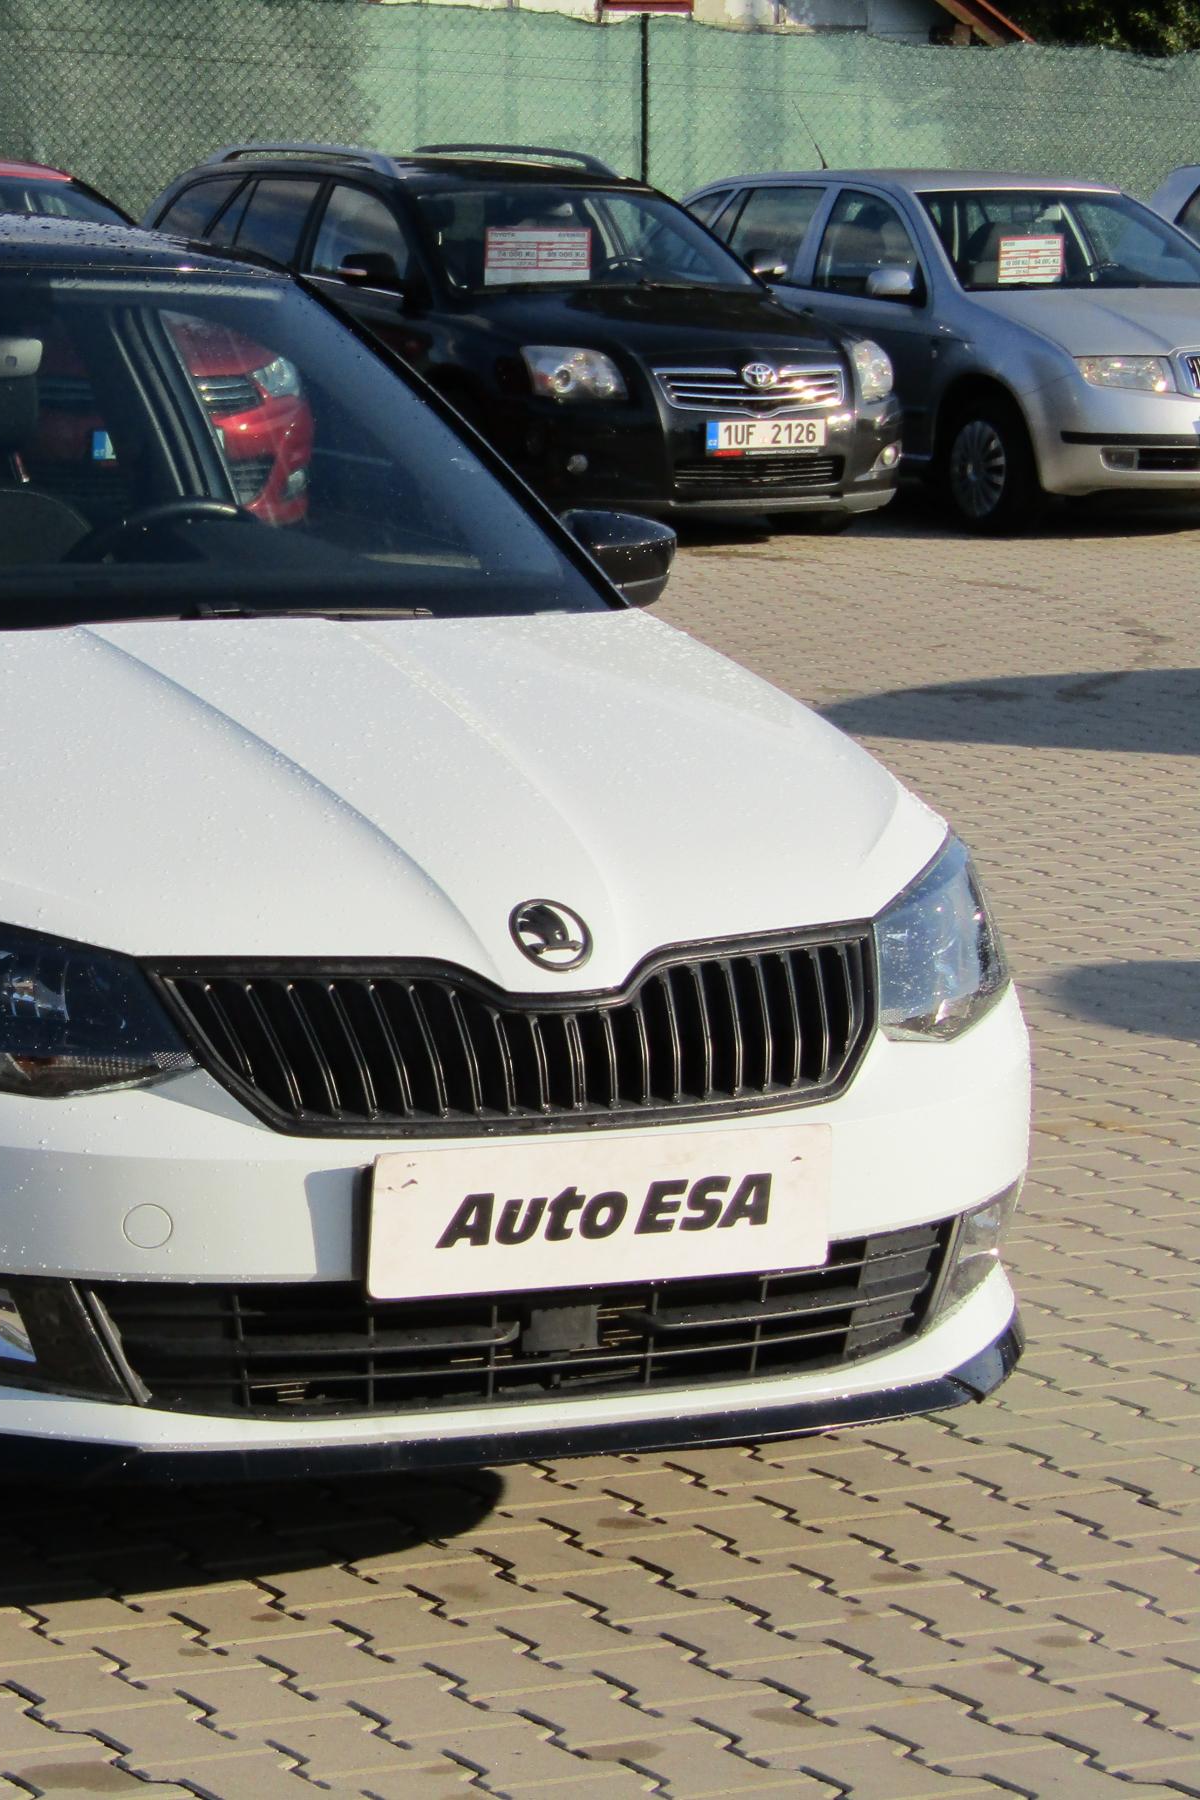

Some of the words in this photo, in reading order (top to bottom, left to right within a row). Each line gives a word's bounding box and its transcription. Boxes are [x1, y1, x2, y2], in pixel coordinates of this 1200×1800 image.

[724, 424, 756, 446] 1UF
[771, 422, 817, 445] 2126
[434, 1185, 629, 1249] Auto
[633, 1172, 773, 1235] ESA
